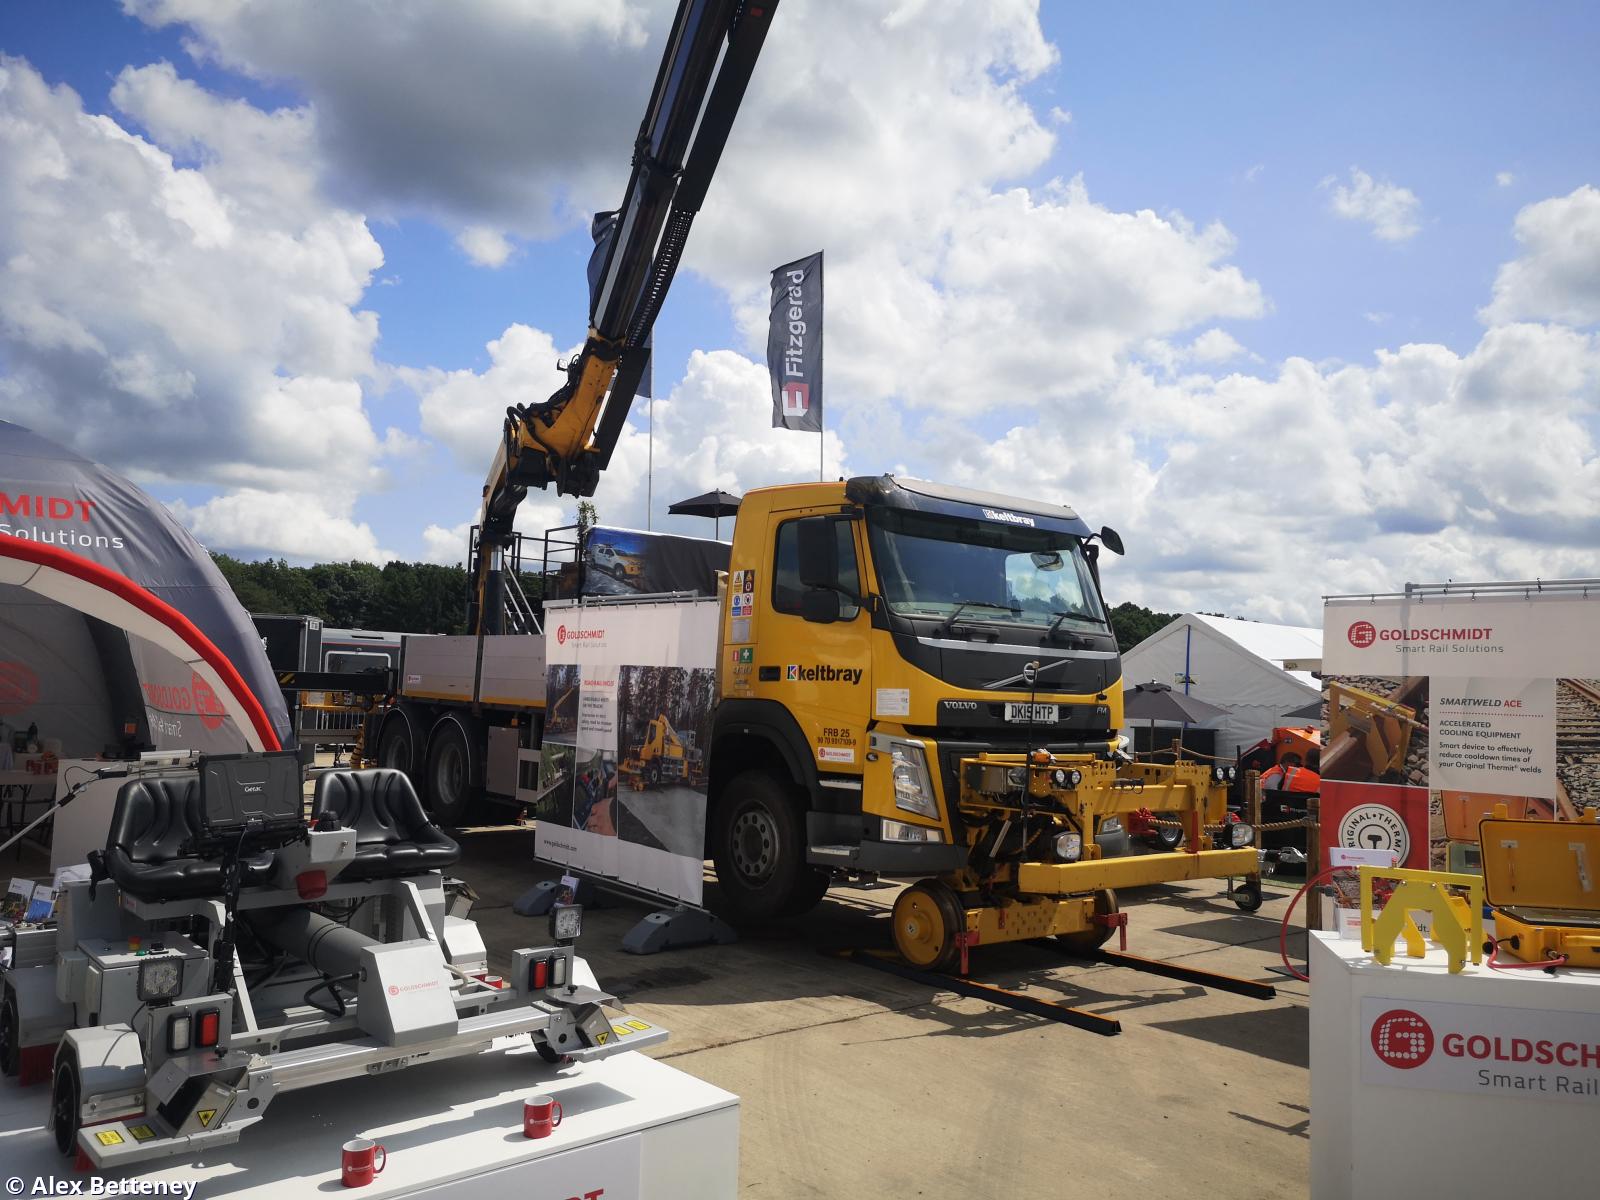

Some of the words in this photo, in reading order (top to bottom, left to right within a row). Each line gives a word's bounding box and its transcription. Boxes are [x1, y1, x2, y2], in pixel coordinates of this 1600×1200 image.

[785, 269, 807, 377] Fitzgerad
[0, 487, 97, 522] MIDT
[992, 511, 1035, 527] keltbray
[0, 523, 124, 549] Solutions
[566, 629, 605, 640] GOLDSCHMIDT
[1379, 628, 1493, 641] GOLDSCHMIDT
[1395, 644, 1425, 653] Smart
[1429, 644, 1449, 653] Rail
[1452, 644, 1504, 653] Solutions
[798, 665, 863, 685] keltbray
[943, 701, 978, 710] VOLVO
[1439, 698, 1502, 707] SMARTWELD
[1503, 699, 1523, 708] ACE
[1034, 705, 1054, 720] HTP
[1439, 720, 1492, 728] ACCELERATED
[823, 728, 839, 737] FRB
[840, 728, 851, 738] 25
[1439, 729, 1474, 737] COOLING
[1475, 730, 1521, 739] EQUIPMENT
[1439, 741, 1460, 749] Smart
[1461, 743, 1486, 751] device
[1496, 745, 1533, 755] effectively
[1439, 751, 1463, 759] reduce
[1464, 752, 1500, 761] cooldown
[1501, 754, 1521, 763] times
[1438, 761, 1454, 769] your
[1455, 761, 1486, 770] Original
[1519, 766, 1542, 774] welds
[244, 785, 263, 793] Getac
[1346, 811, 1372, 849] RIGINAL
[1377, 812, 1402, 854] THERMI
[1441, 1032, 1600, 1069] GOLDSCH
[1477, 1069, 1547, 1092] Smart
[1555, 1075, 1599, 1096] Rail
